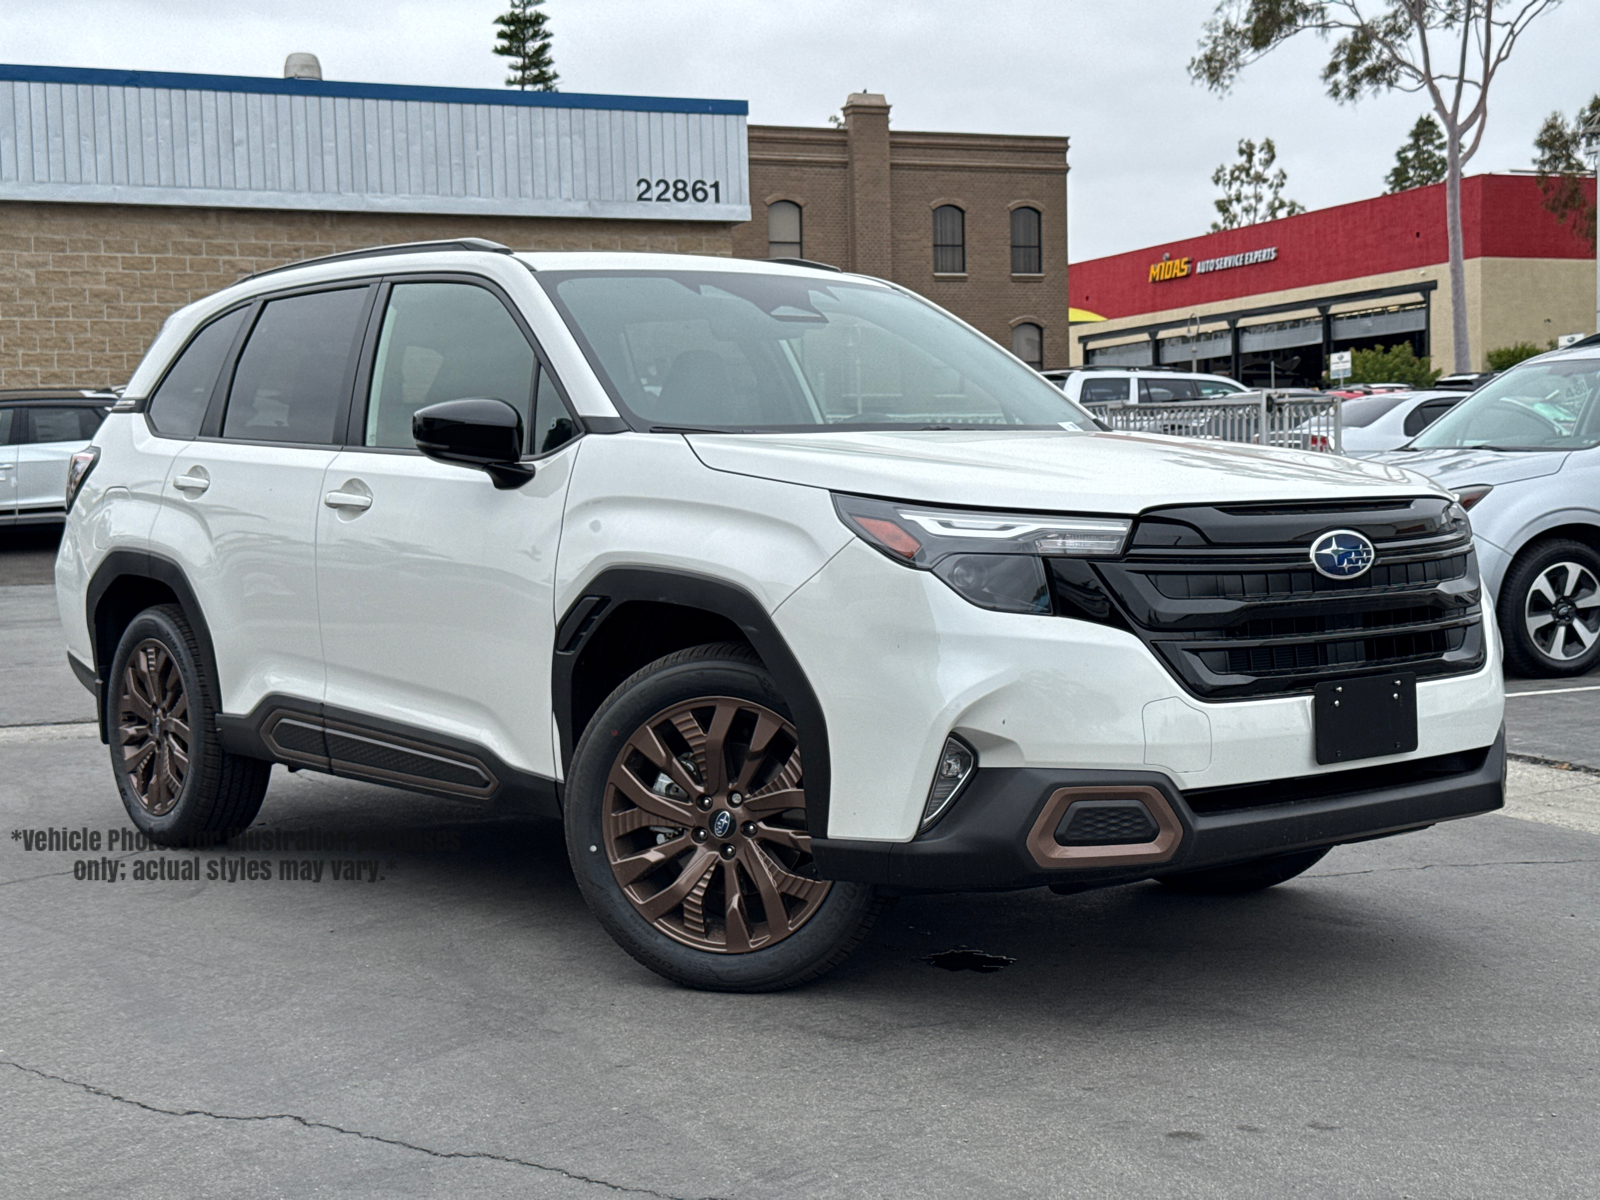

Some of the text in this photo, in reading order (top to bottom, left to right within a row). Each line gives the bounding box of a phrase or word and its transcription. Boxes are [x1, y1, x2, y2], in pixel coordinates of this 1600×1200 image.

[636, 178, 720, 203] 22861
[1148, 247, 1278, 283] MIDAS AUTO SERVICE EXPERTS
